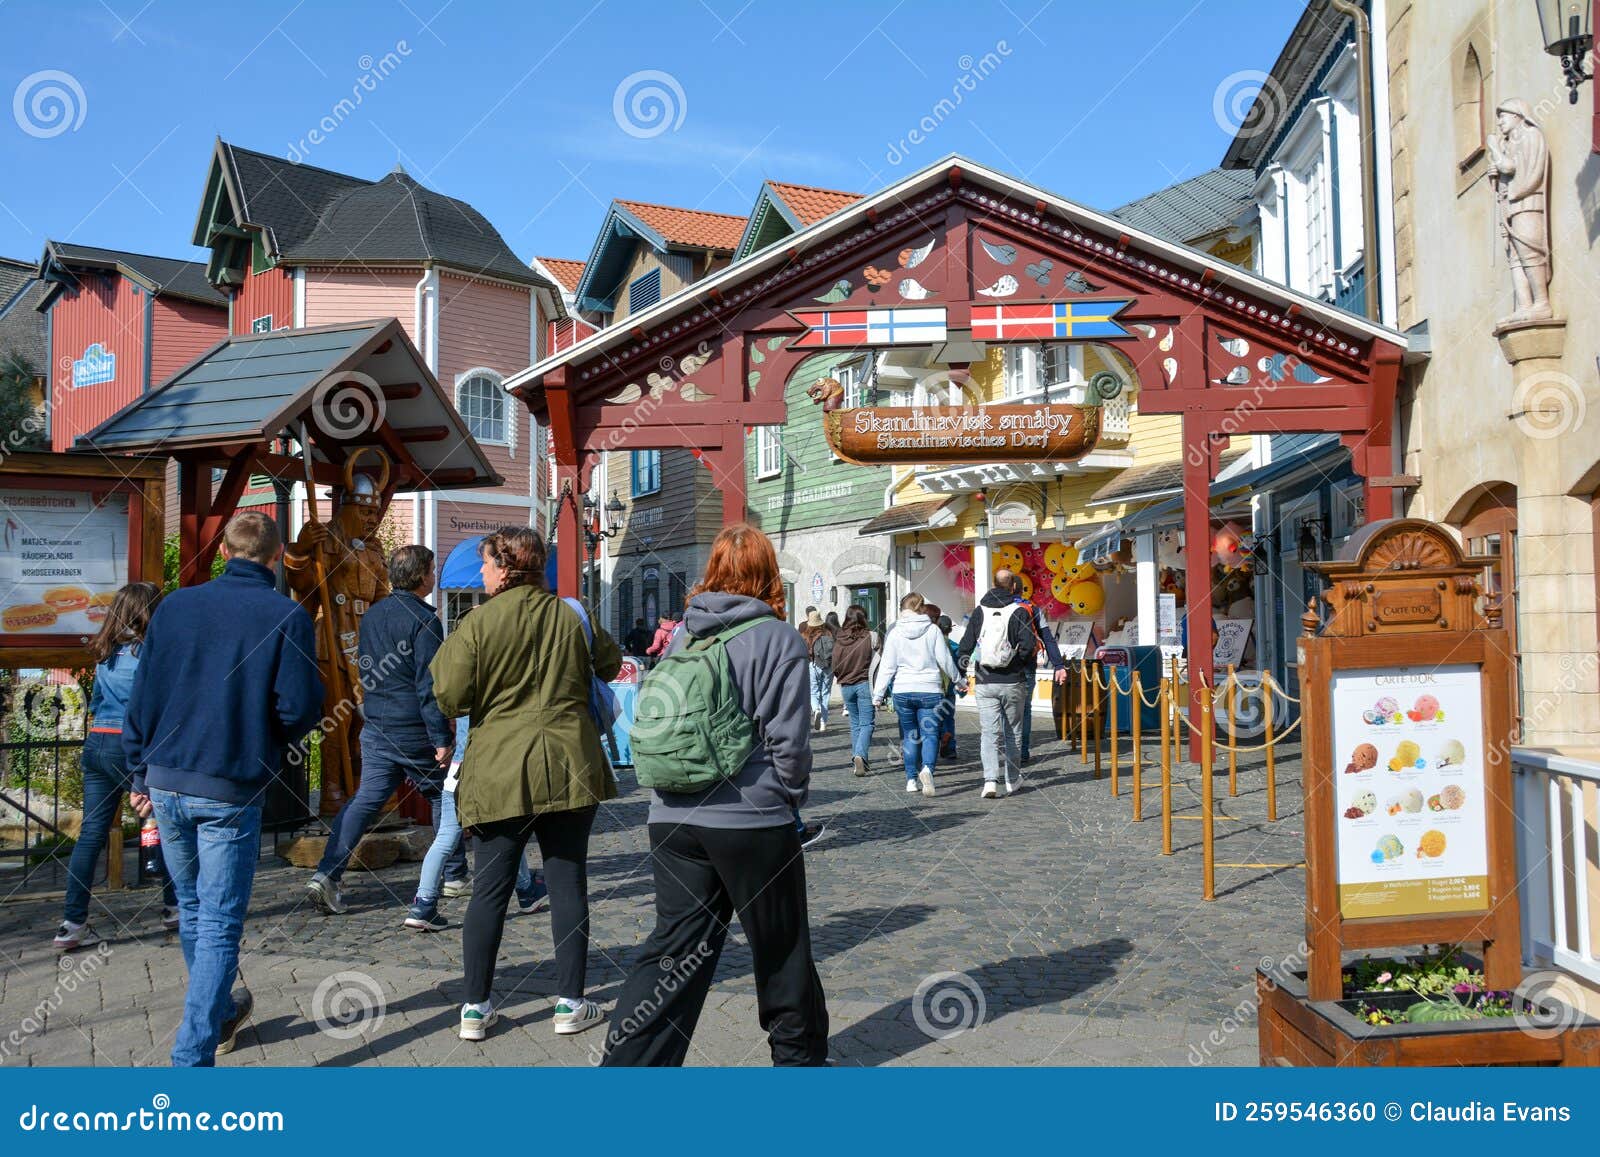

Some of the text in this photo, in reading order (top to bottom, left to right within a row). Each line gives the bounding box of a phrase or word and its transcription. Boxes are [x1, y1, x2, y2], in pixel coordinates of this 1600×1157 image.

[855, 409, 1073, 437] Skandinavisk småby
[876, 430, 1051, 450] Skandinavisches Dorf
[450, 516, 512, 532] Sportsbuti
[1383, 606, 1410, 616] CARTE
[1375, 674, 1407, 686] CARTE
